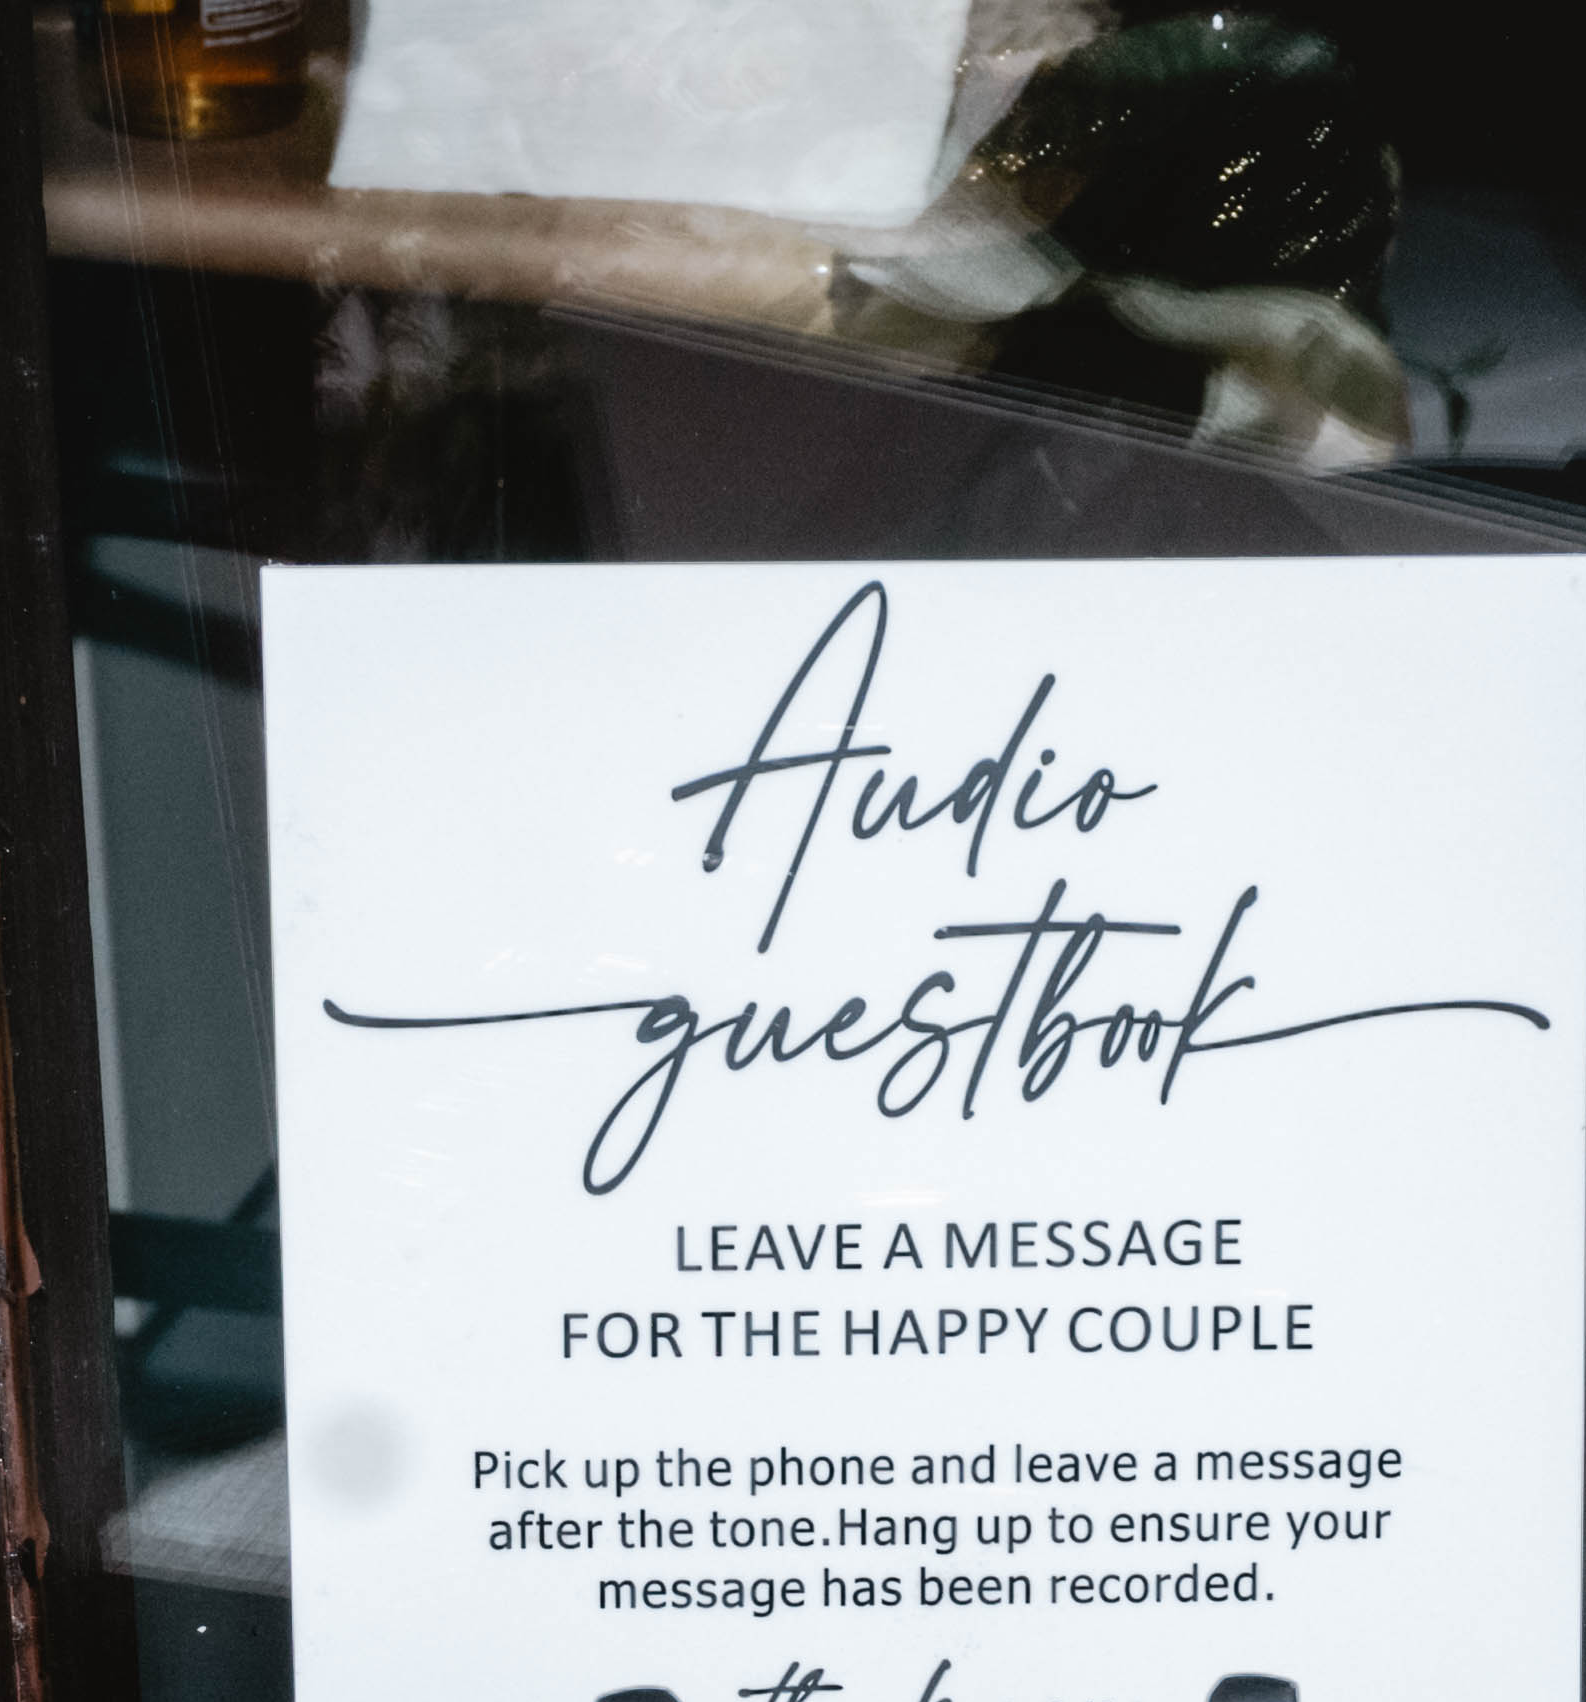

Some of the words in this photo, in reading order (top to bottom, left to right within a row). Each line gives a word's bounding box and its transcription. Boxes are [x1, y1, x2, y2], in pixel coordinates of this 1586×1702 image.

[669, 579, 1160, 953] Audio
[321, 879, 1552, 1196] guestbook
[677, 1223, 863, 1272] LEAVE
[882, 1222, 924, 1270] A
[945, 1218, 1242, 1269] MESSAGE
[563, 1310, 683, 1359] FOR
[700, 1310, 820, 1358] THE
[844, 1307, 1049, 1356] HAPPY
[1068, 1303, 1314, 1354] COUPLE
[474, 1448, 568, 1490] Pick
[584, 1457, 640, 1498] up
[655, 1447, 732, 1488] the
[750, 1446, 895, 1497] phone
[911, 1443, 996, 1486] and
[1015, 1443, 1138, 1484] leave
[1153, 1451, 1177, 1482] a
[1196, 1443, 1402, 1489] message
[489, 1509, 603, 1551] after
[617, 1508, 694, 1549] the
[976, 1514, 1032, 1555] up
[1047, 1506, 1094, 1544] to
[1109, 1509, 1271, 1544] ensure
[1285, 1507, 1392, 1552] your
[599, 1574, 806, 1618] message
[823, 1567, 903, 1608] has
[919, 1566, 1031, 1607] been
[1050, 1561, 1276, 1605] recorded.
